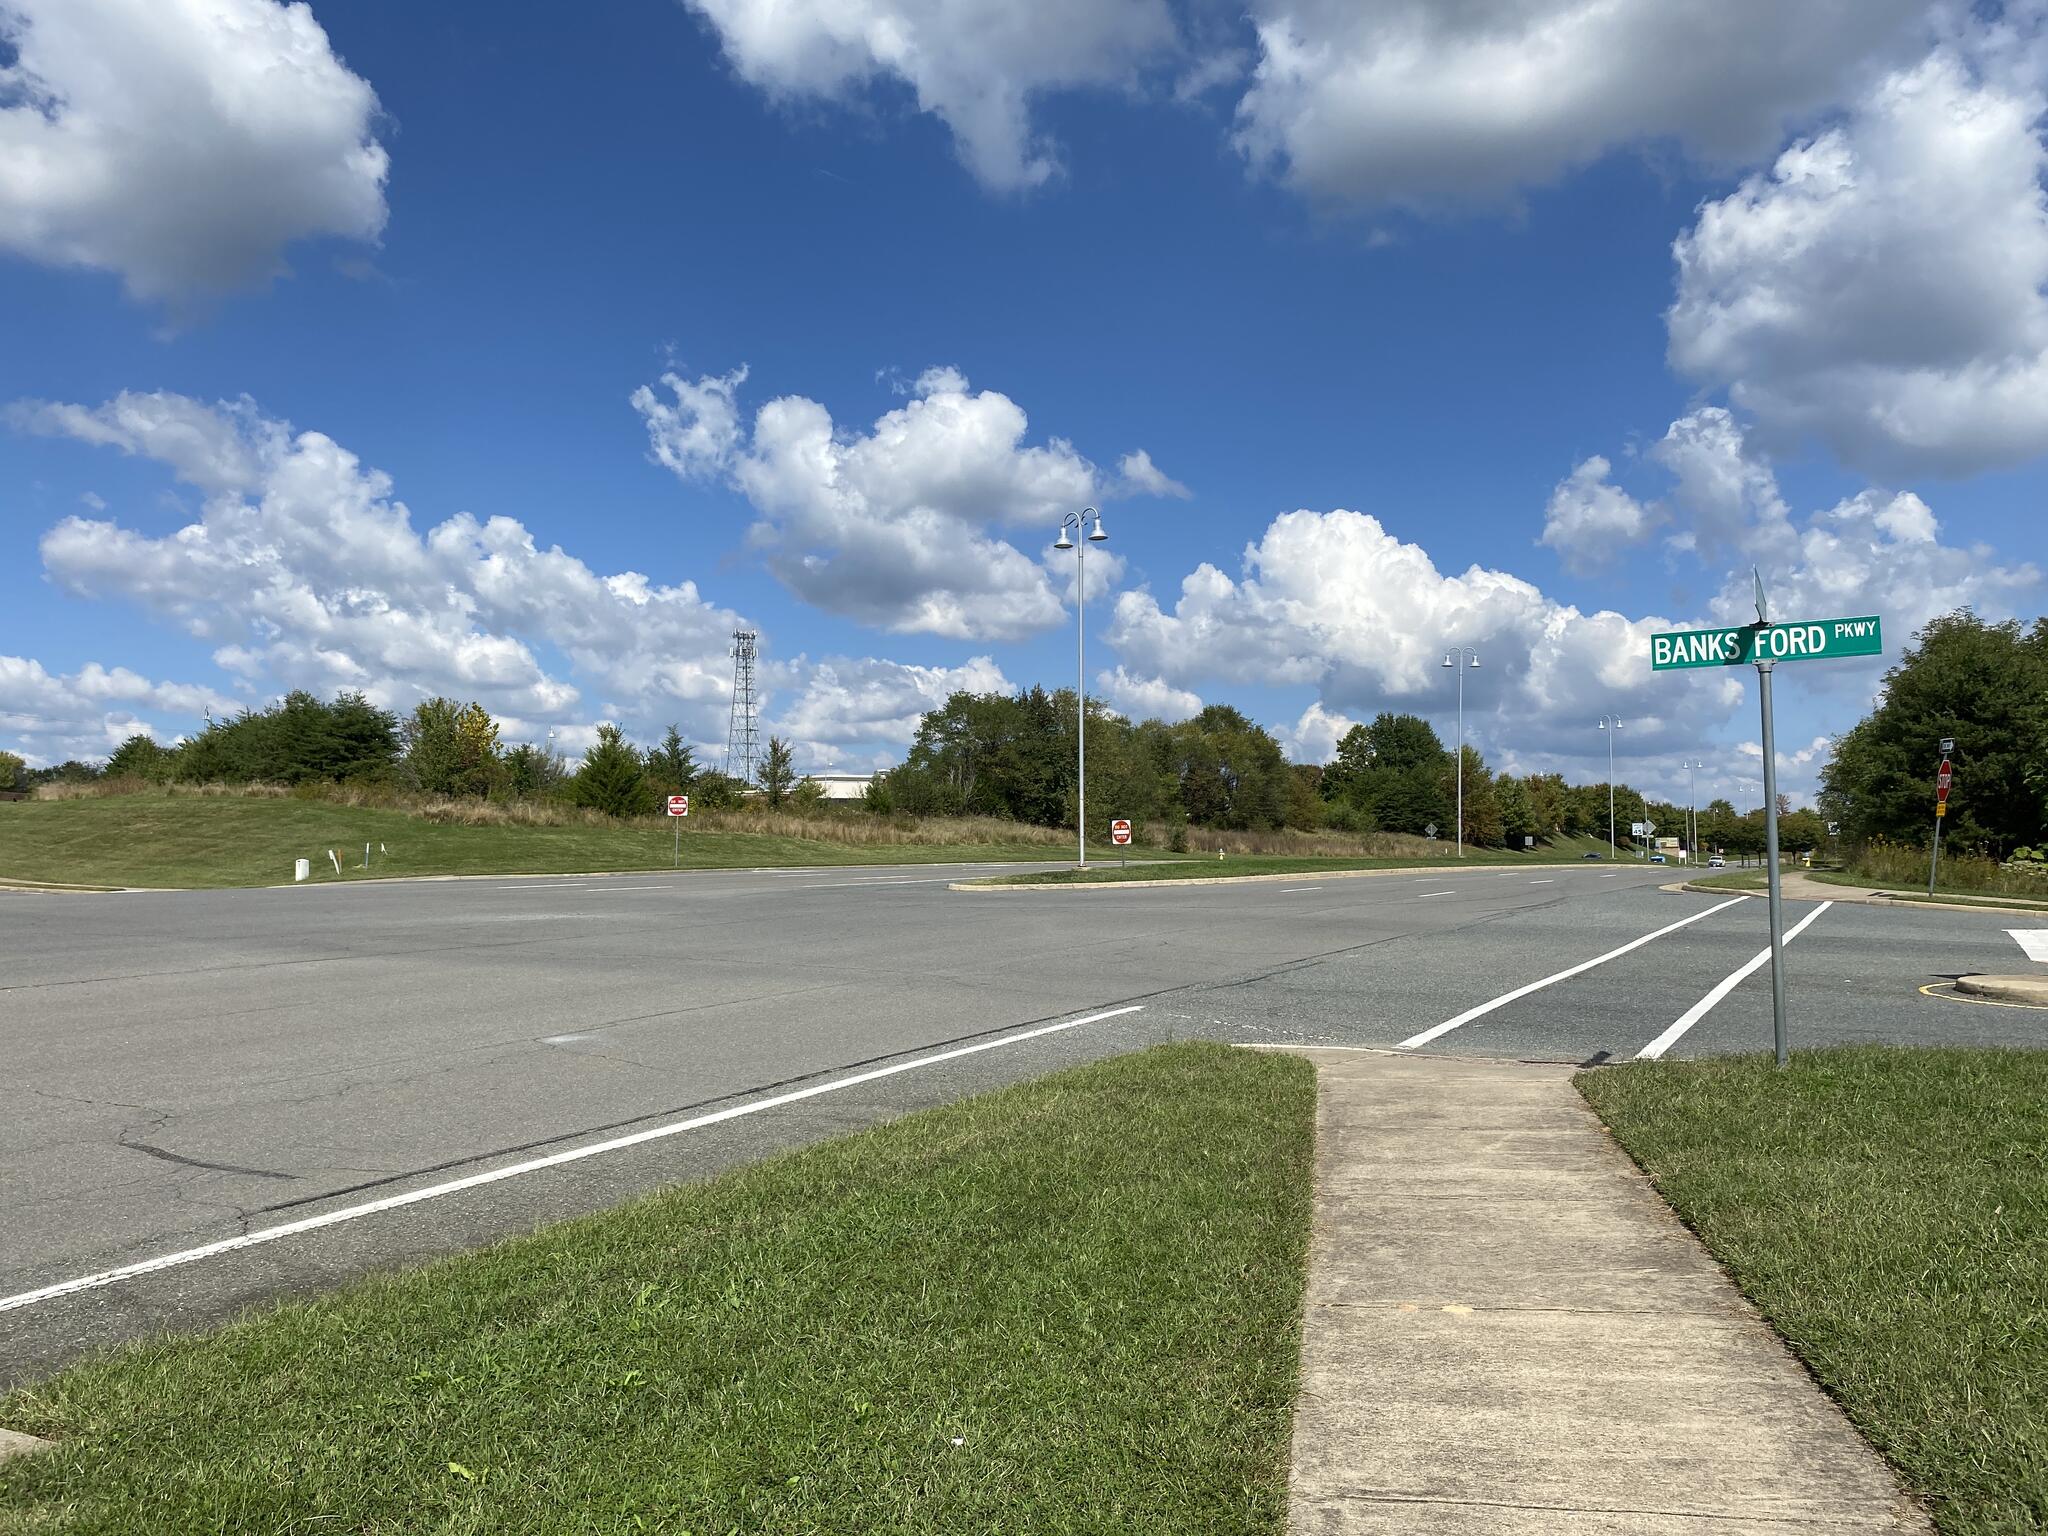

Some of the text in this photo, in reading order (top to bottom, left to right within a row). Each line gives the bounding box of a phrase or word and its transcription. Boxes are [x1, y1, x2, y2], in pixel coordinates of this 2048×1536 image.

[1654, 621, 1876, 664] BANKS FORD PKWY
[1938, 773, 1951, 789] STOP
